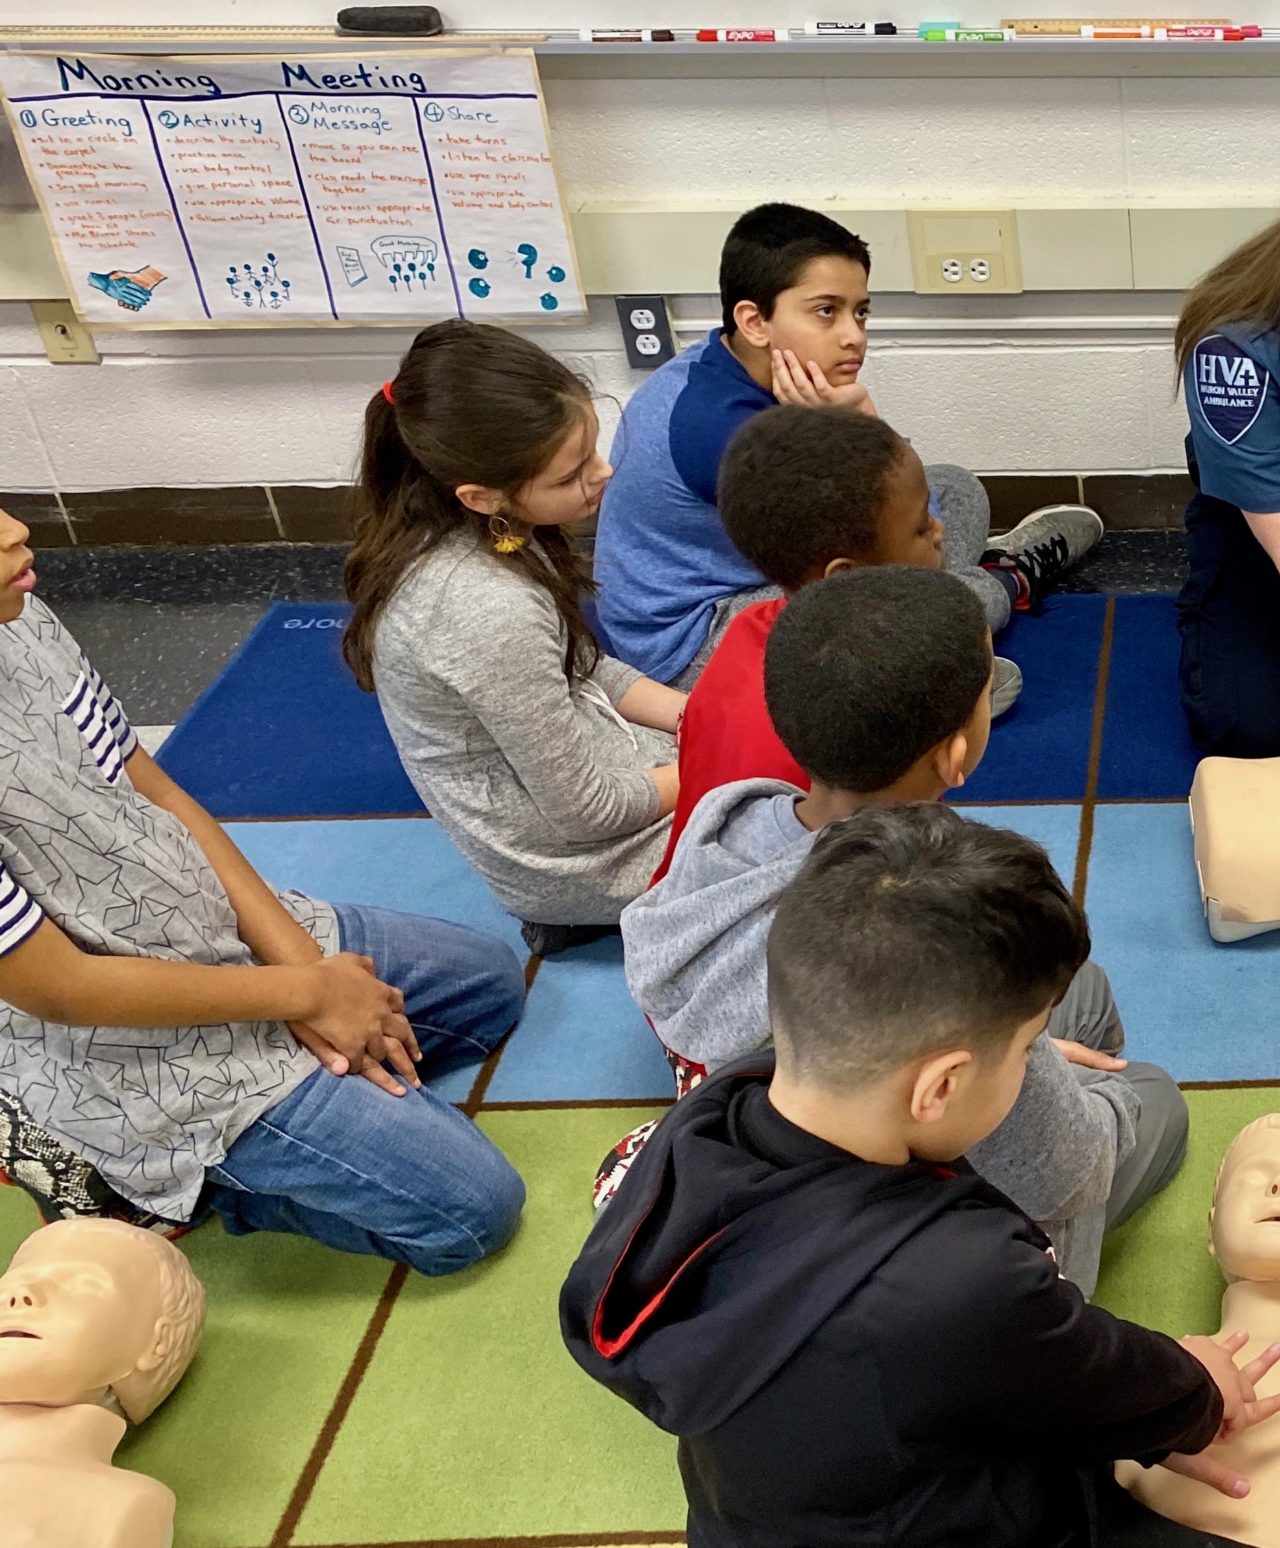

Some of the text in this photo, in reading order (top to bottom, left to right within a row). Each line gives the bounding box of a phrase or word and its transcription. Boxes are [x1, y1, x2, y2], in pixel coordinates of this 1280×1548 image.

[728, 31, 754, 42] EXPO
[56, 57, 427, 96] Morning Meeting
[310, 101, 382, 120] Morning
[447, 106, 498, 123] Share
[42, 109, 132, 136] Greeting
[183, 113, 262, 134] Activity
[313, 117, 393, 135] Message
[446, 133, 507, 145] take turns
[234, 164, 271, 173] control
[211, 179, 256, 190] personal
[261, 180, 293, 188] space
[322, 183, 367, 196] together
[347, 216, 413, 227] punctuation
[1199, 354, 1260, 386] HVA
[1200, 385, 1259, 396] HURON VALLEY
[1204, 396, 1254, 407] AMBULANCE
